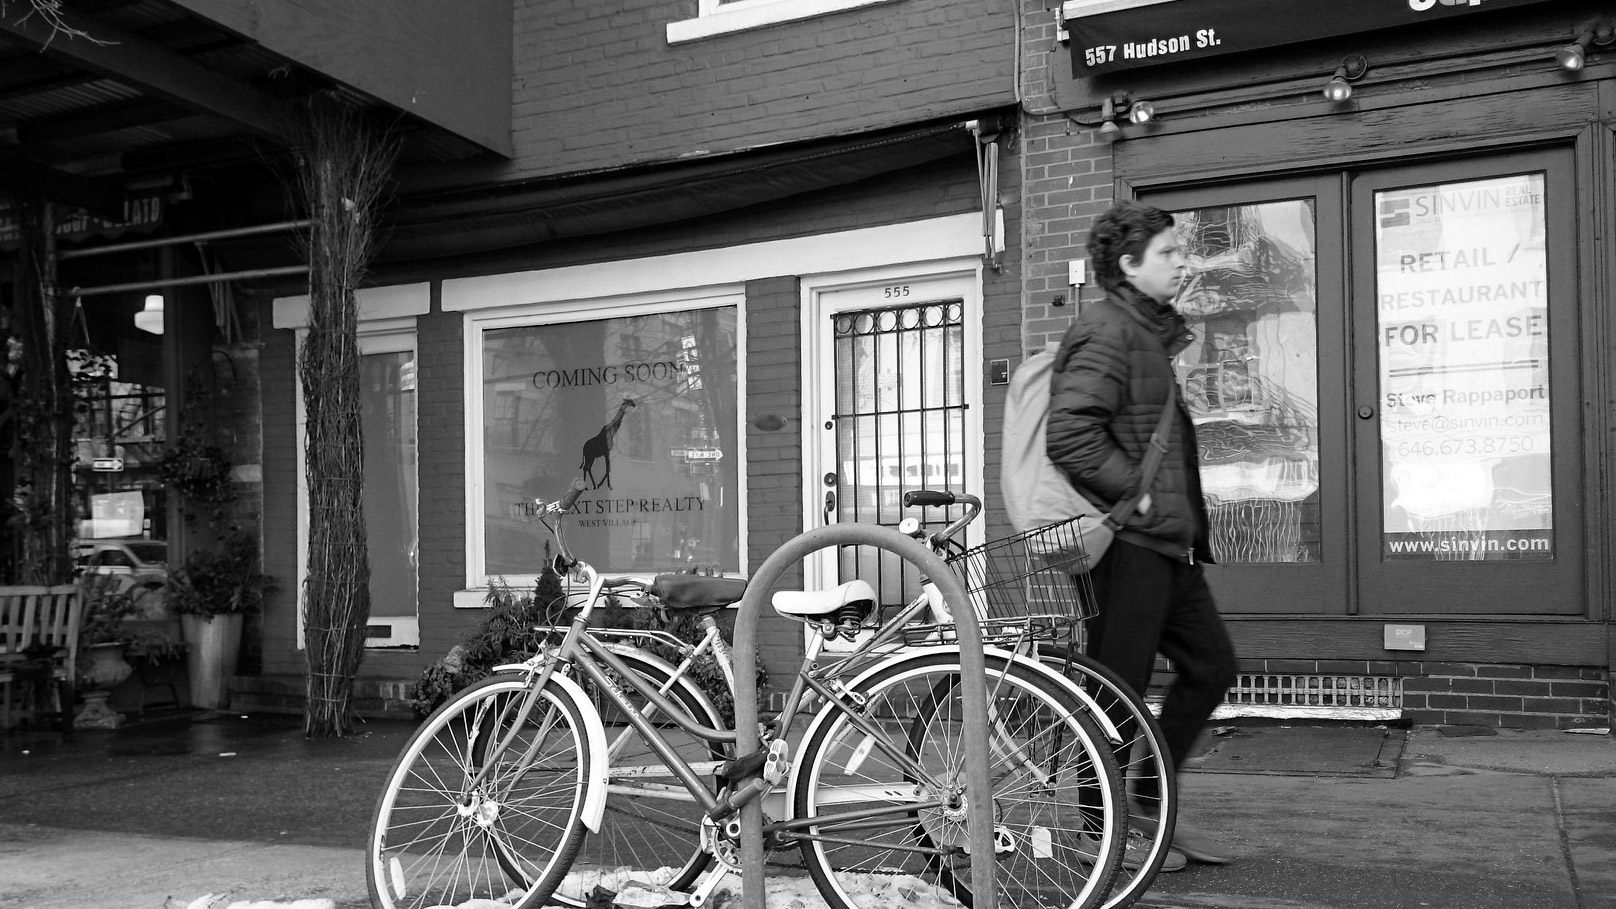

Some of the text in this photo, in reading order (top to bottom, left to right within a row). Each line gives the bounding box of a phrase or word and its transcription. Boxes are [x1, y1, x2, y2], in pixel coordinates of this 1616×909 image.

[1085, 28, 1222, 68] 557 Hudson St.
[1505, 185, 1532, 196] REAL
[1505, 194, 1541, 207] ESTATE
[1416, 188, 1500, 217] SINVIN
[1400, 247, 1496, 274] RETAIL
[884, 286, 910, 298] 555
[1380, 280, 1543, 311] RESTAURANT
[1385, 315, 1542, 347] FOR LEASE
[533, 361, 684, 390] COMING SOON
[1443, 385, 1545, 406] Rappaport
[1389, 413, 1543, 433] steve@sinvin.com
[1399, 436, 1534, 457] 646.673.8750
[515, 502, 545, 516] TH
[596, 499, 634, 515] STEP
[639, 496, 706, 513] REALTY
[579, 519, 601, 528] WEST
[1389, 536, 1550, 553] www.sinvin.com
